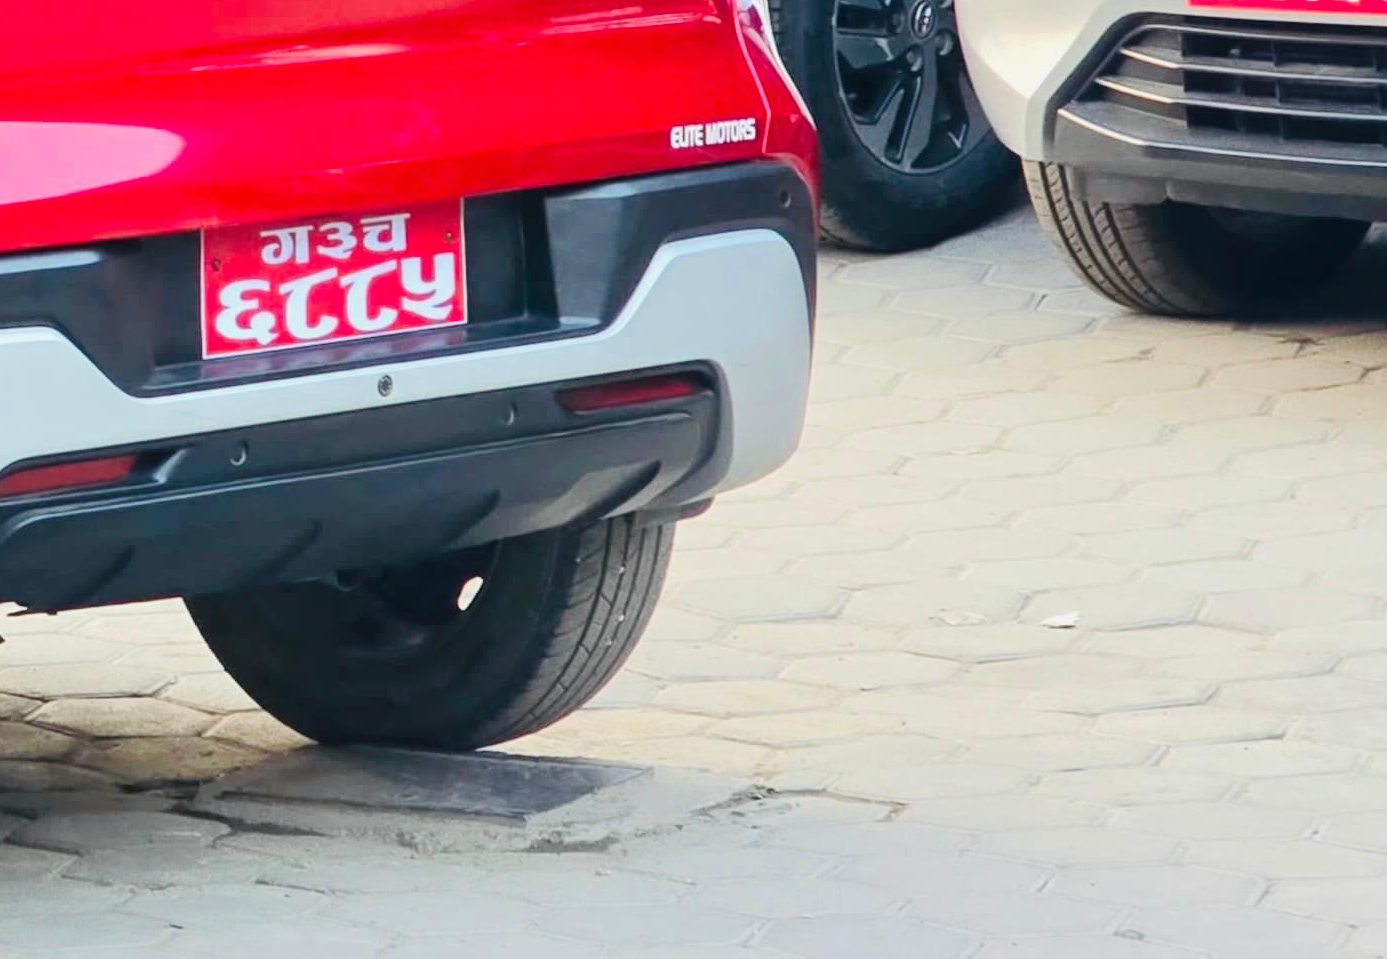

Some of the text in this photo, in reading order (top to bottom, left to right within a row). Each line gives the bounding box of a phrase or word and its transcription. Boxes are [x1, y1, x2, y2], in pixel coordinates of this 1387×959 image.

[670, 117, 756, 149] ELITE MOTORS
[215, 251, 457, 346] ६८८५
